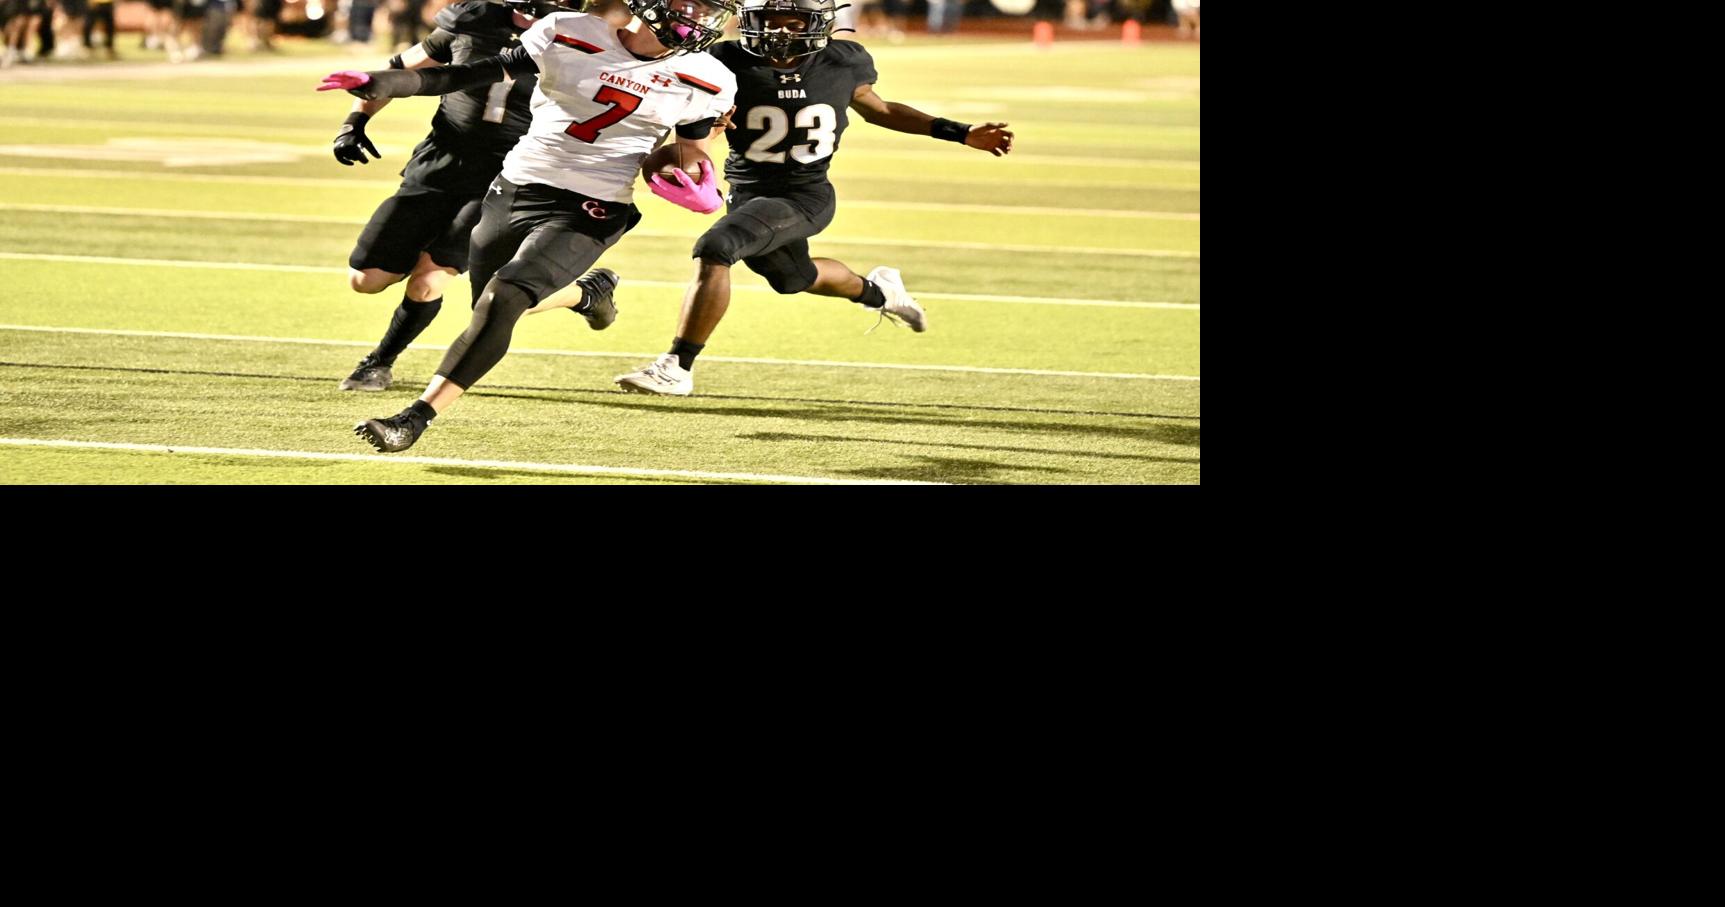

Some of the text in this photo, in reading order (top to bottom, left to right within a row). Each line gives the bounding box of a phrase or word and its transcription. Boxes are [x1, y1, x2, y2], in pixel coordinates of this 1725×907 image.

[599, 71, 650, 95] CANYON
[777, 88, 807, 99] BUDA
[564, 84, 644, 144] 7
[744, 103, 837, 164] 23
[581, 200, 607, 220] CC
